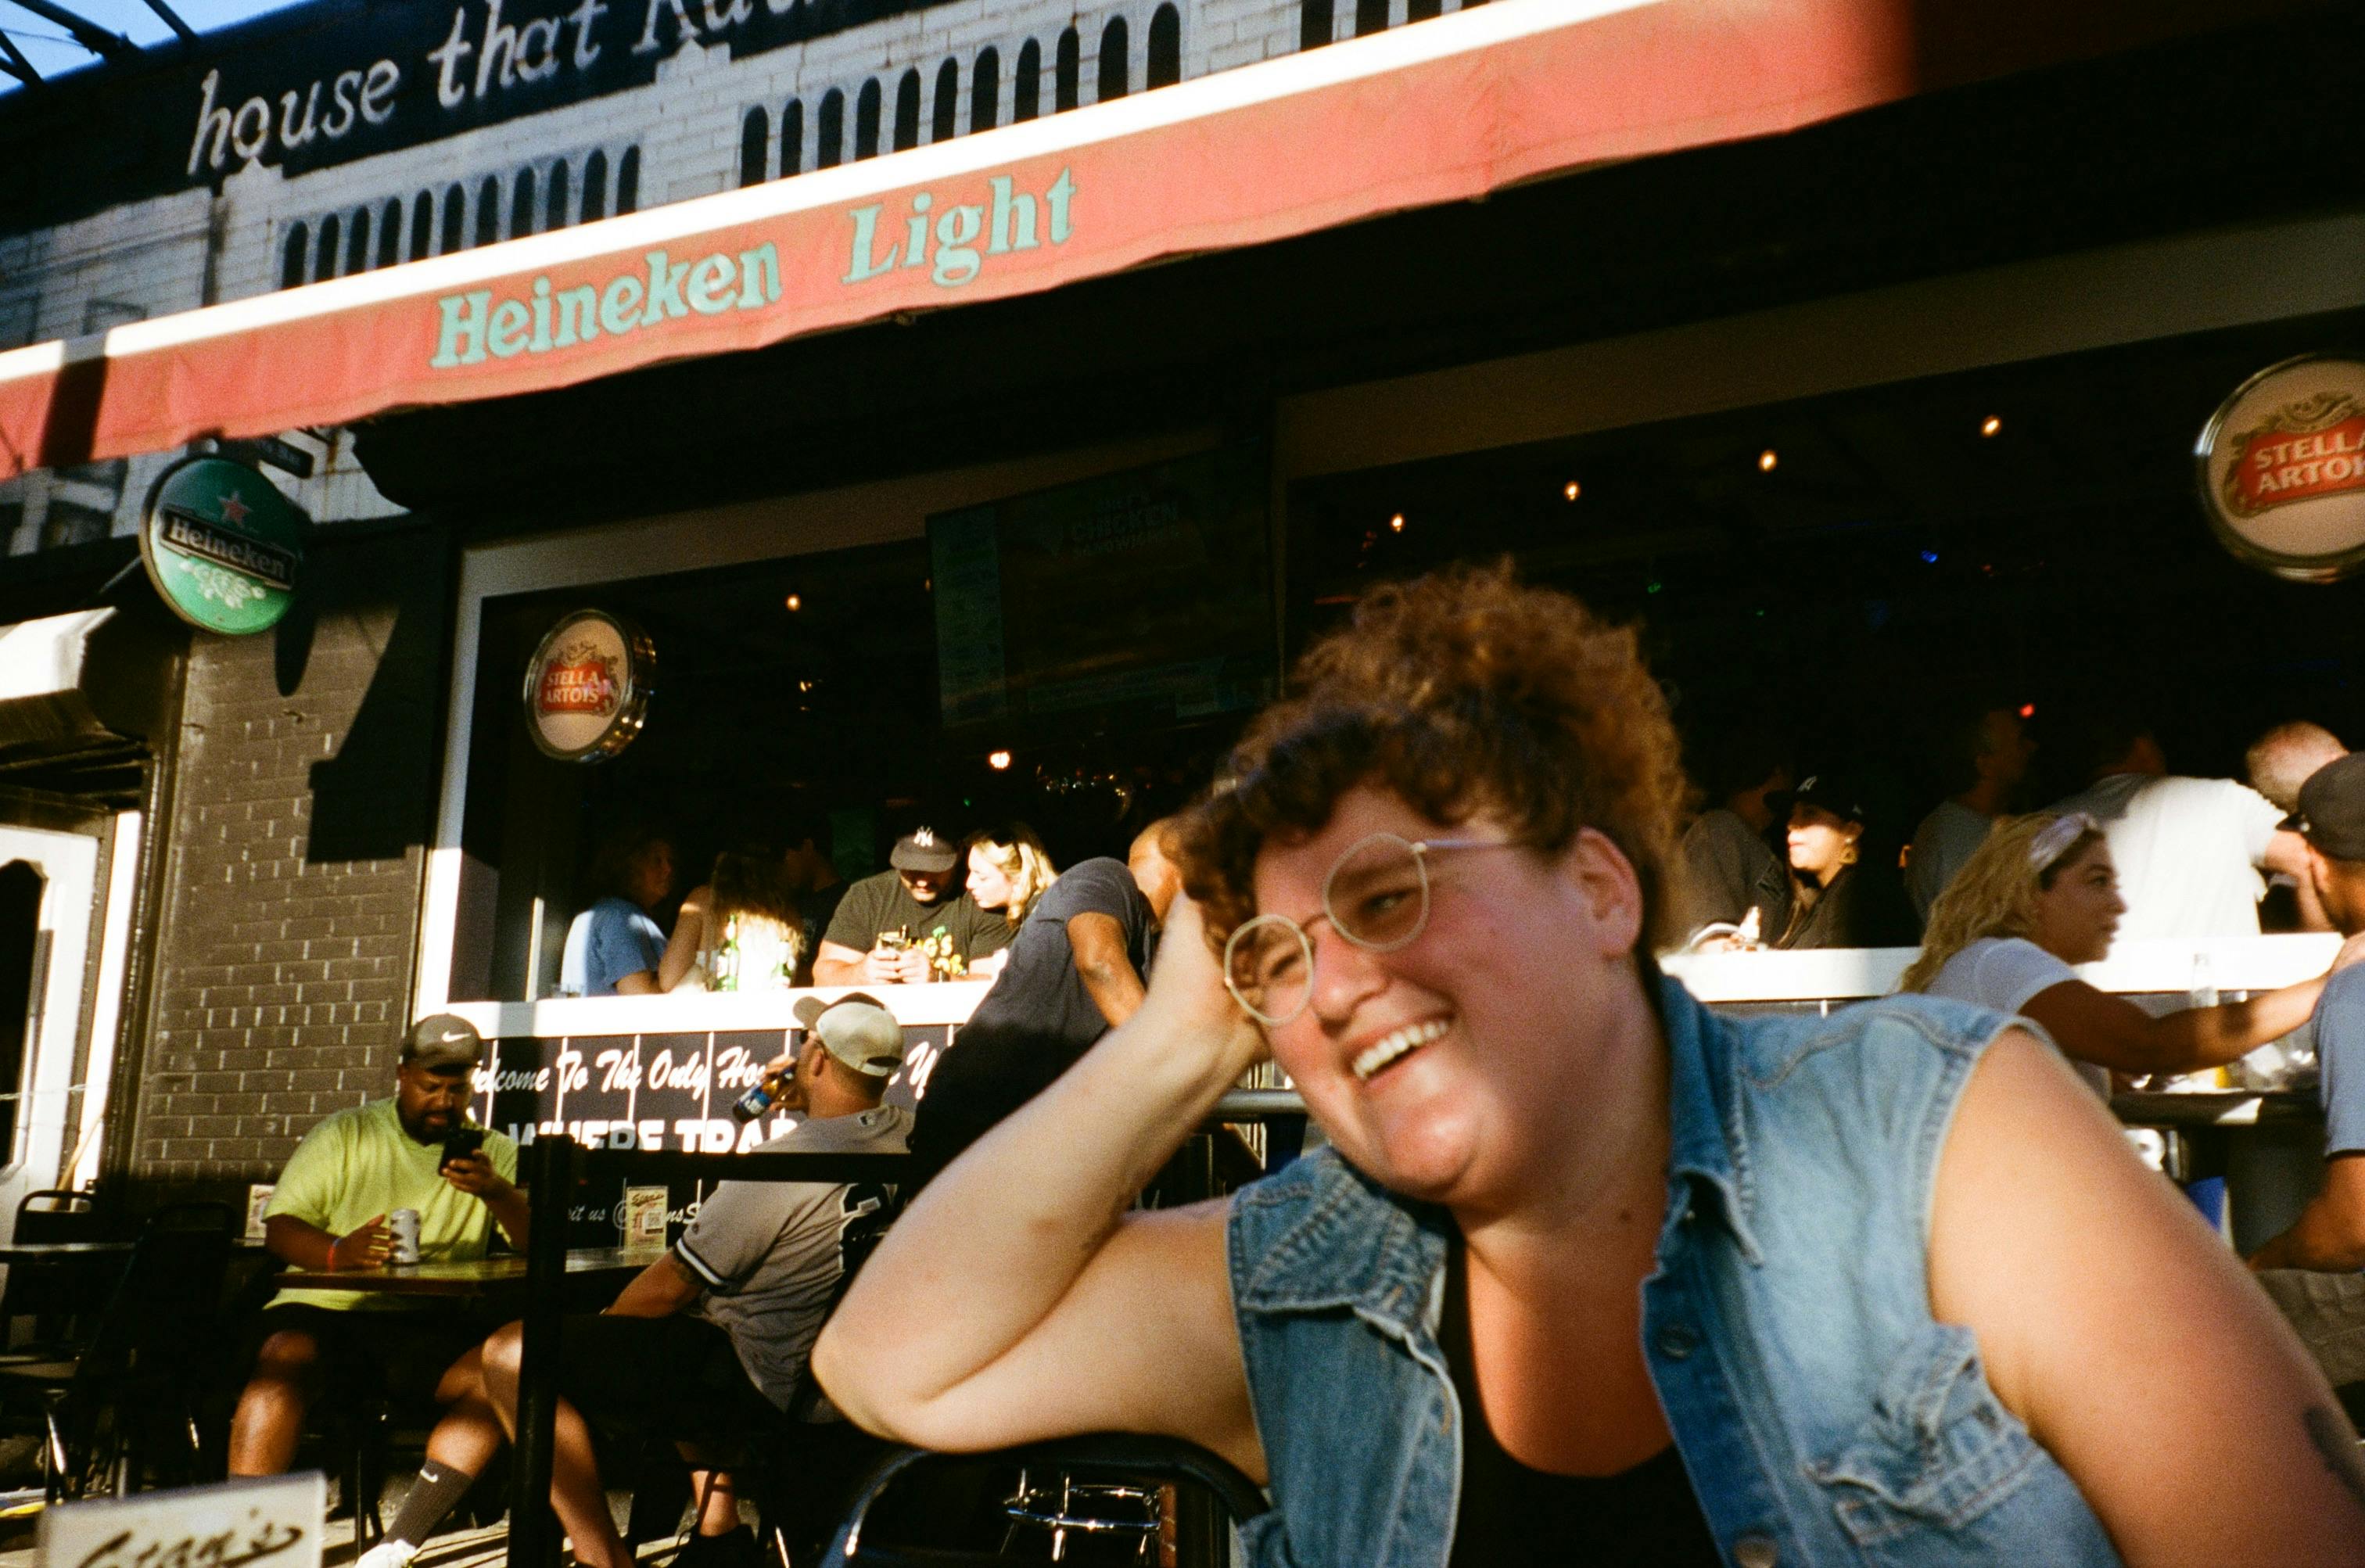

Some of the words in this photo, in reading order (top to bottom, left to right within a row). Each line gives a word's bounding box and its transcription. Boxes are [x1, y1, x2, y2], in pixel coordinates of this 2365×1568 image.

[187, 59, 400, 176] house
[426, 0, 608, 108] that
[430, 241, 783, 368] Heineken
[842, 166, 1078, 287] Light
[169, 516, 285, 579] Heineken
[546, 687, 599, 703] ARTOIS
[547, 669, 600, 687] STELLA
[471, 1057, 550, 1093] elcome
[556, 1050, 588, 1093] To
[595, 1049, 642, 1093] The
[648, 1048, 710, 1101] Only
